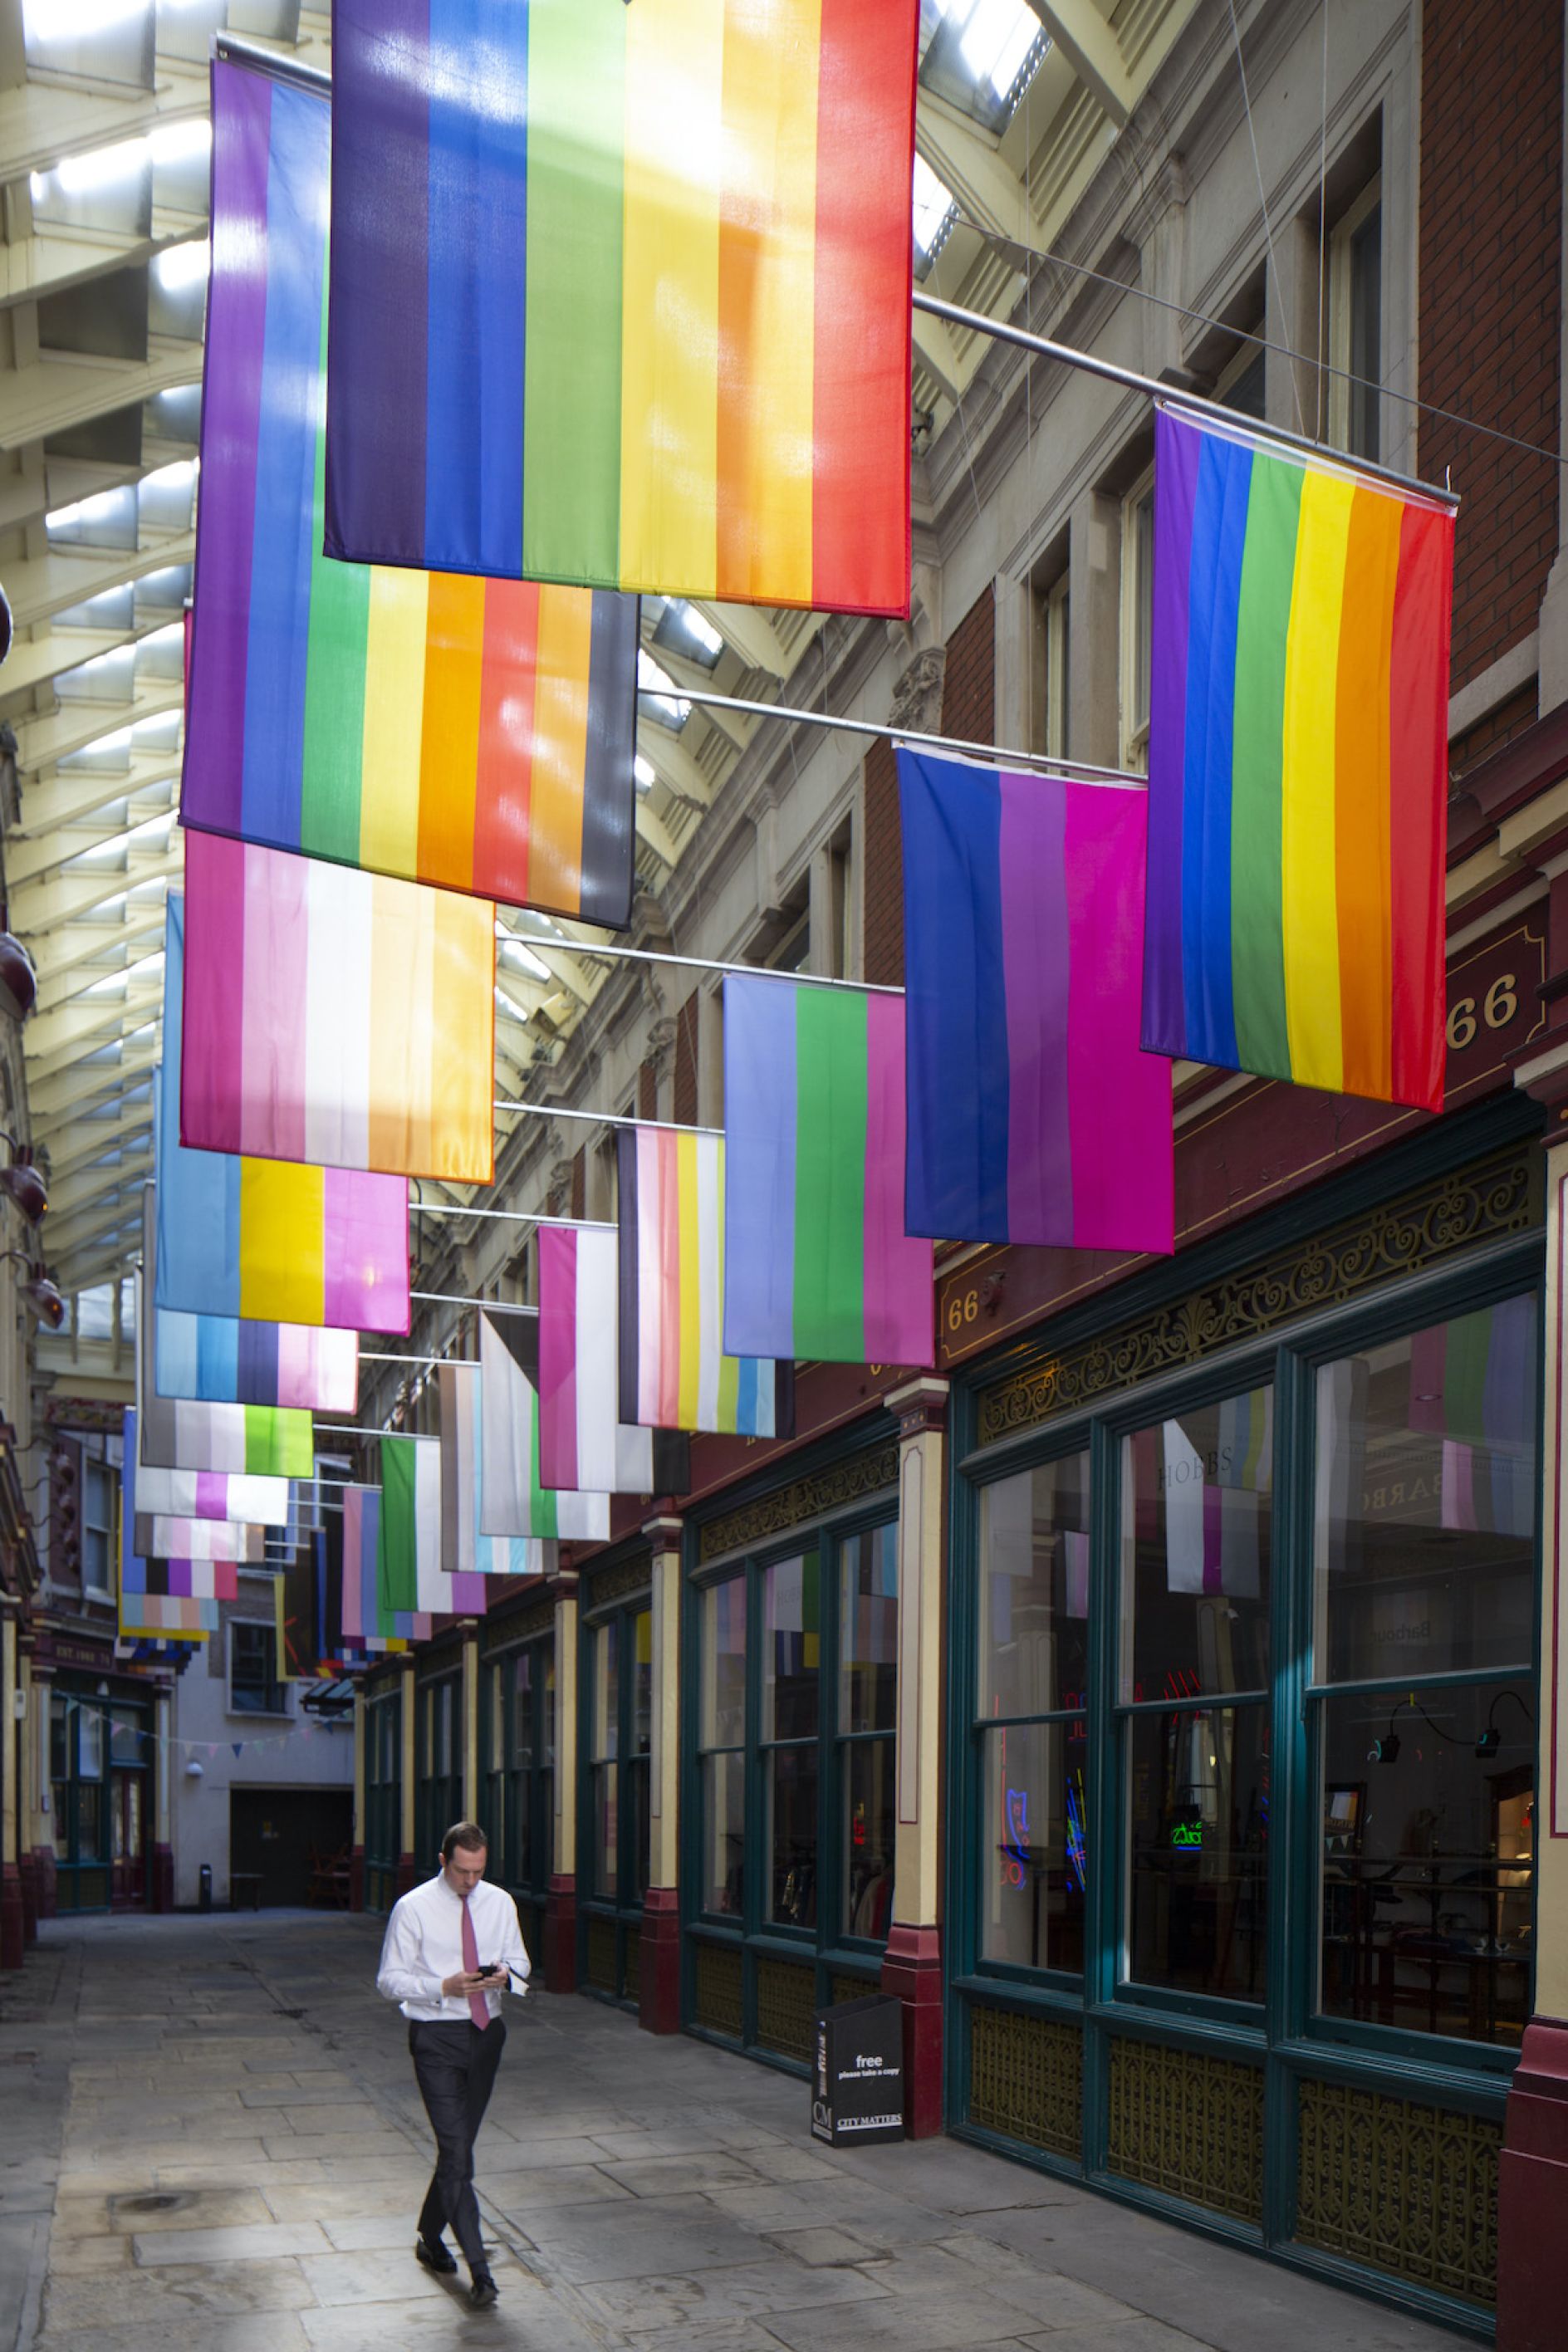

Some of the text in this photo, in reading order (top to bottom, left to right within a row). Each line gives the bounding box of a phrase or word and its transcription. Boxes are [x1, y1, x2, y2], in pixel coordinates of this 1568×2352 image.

[1447, 973, 1517, 1050] 66
[948, 1290, 978, 1330] 66
[1158, 1446, 1232, 1490] HOBBS
[838, 2071, 860, 2080] please
[883, 2068, 900, 2077] copy
[856, 2055, 883, 2068] free
[837, 2114, 903, 2127] CITY MATTERS
